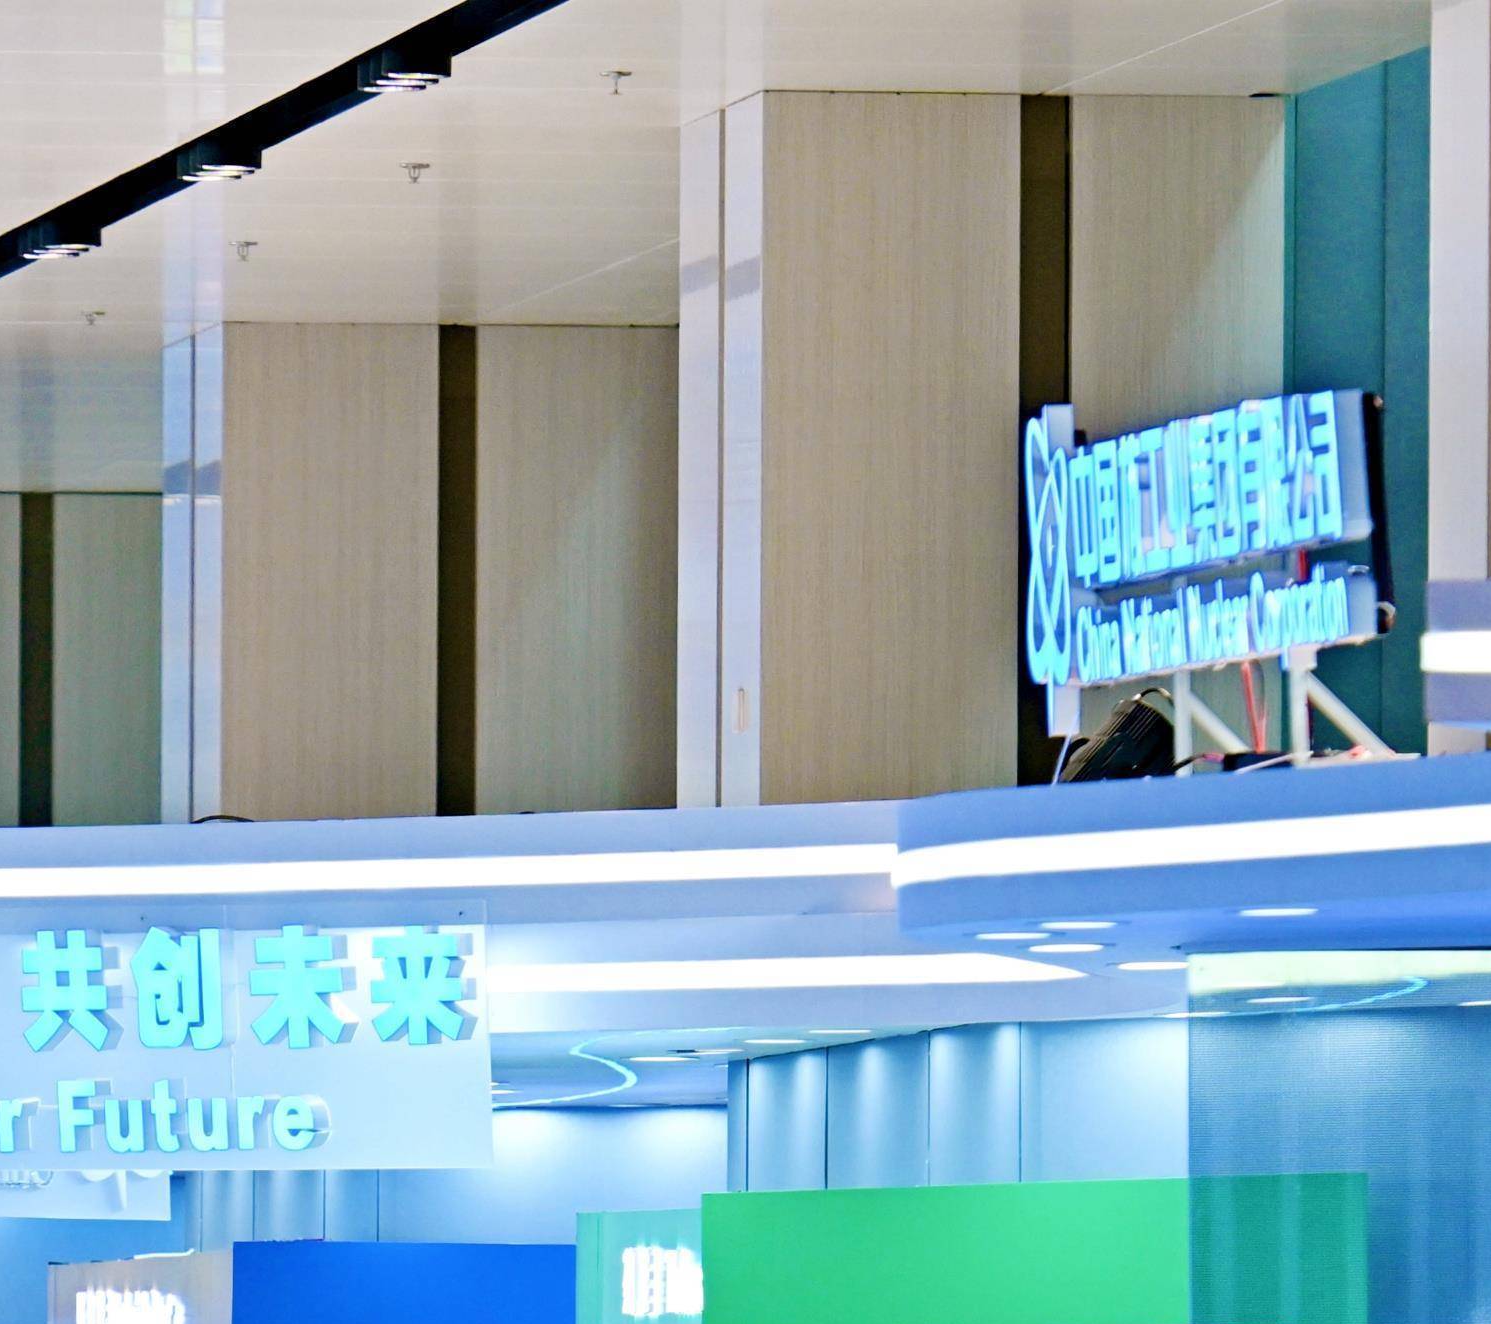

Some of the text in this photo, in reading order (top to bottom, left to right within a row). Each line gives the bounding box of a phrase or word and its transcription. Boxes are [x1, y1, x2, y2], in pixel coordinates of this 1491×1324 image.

[1076, 562, 1350, 683] China National Nuclear Corporation
[20, 924, 467, 1051] 共创未来
[58, 1079, 318, 1154] Future
